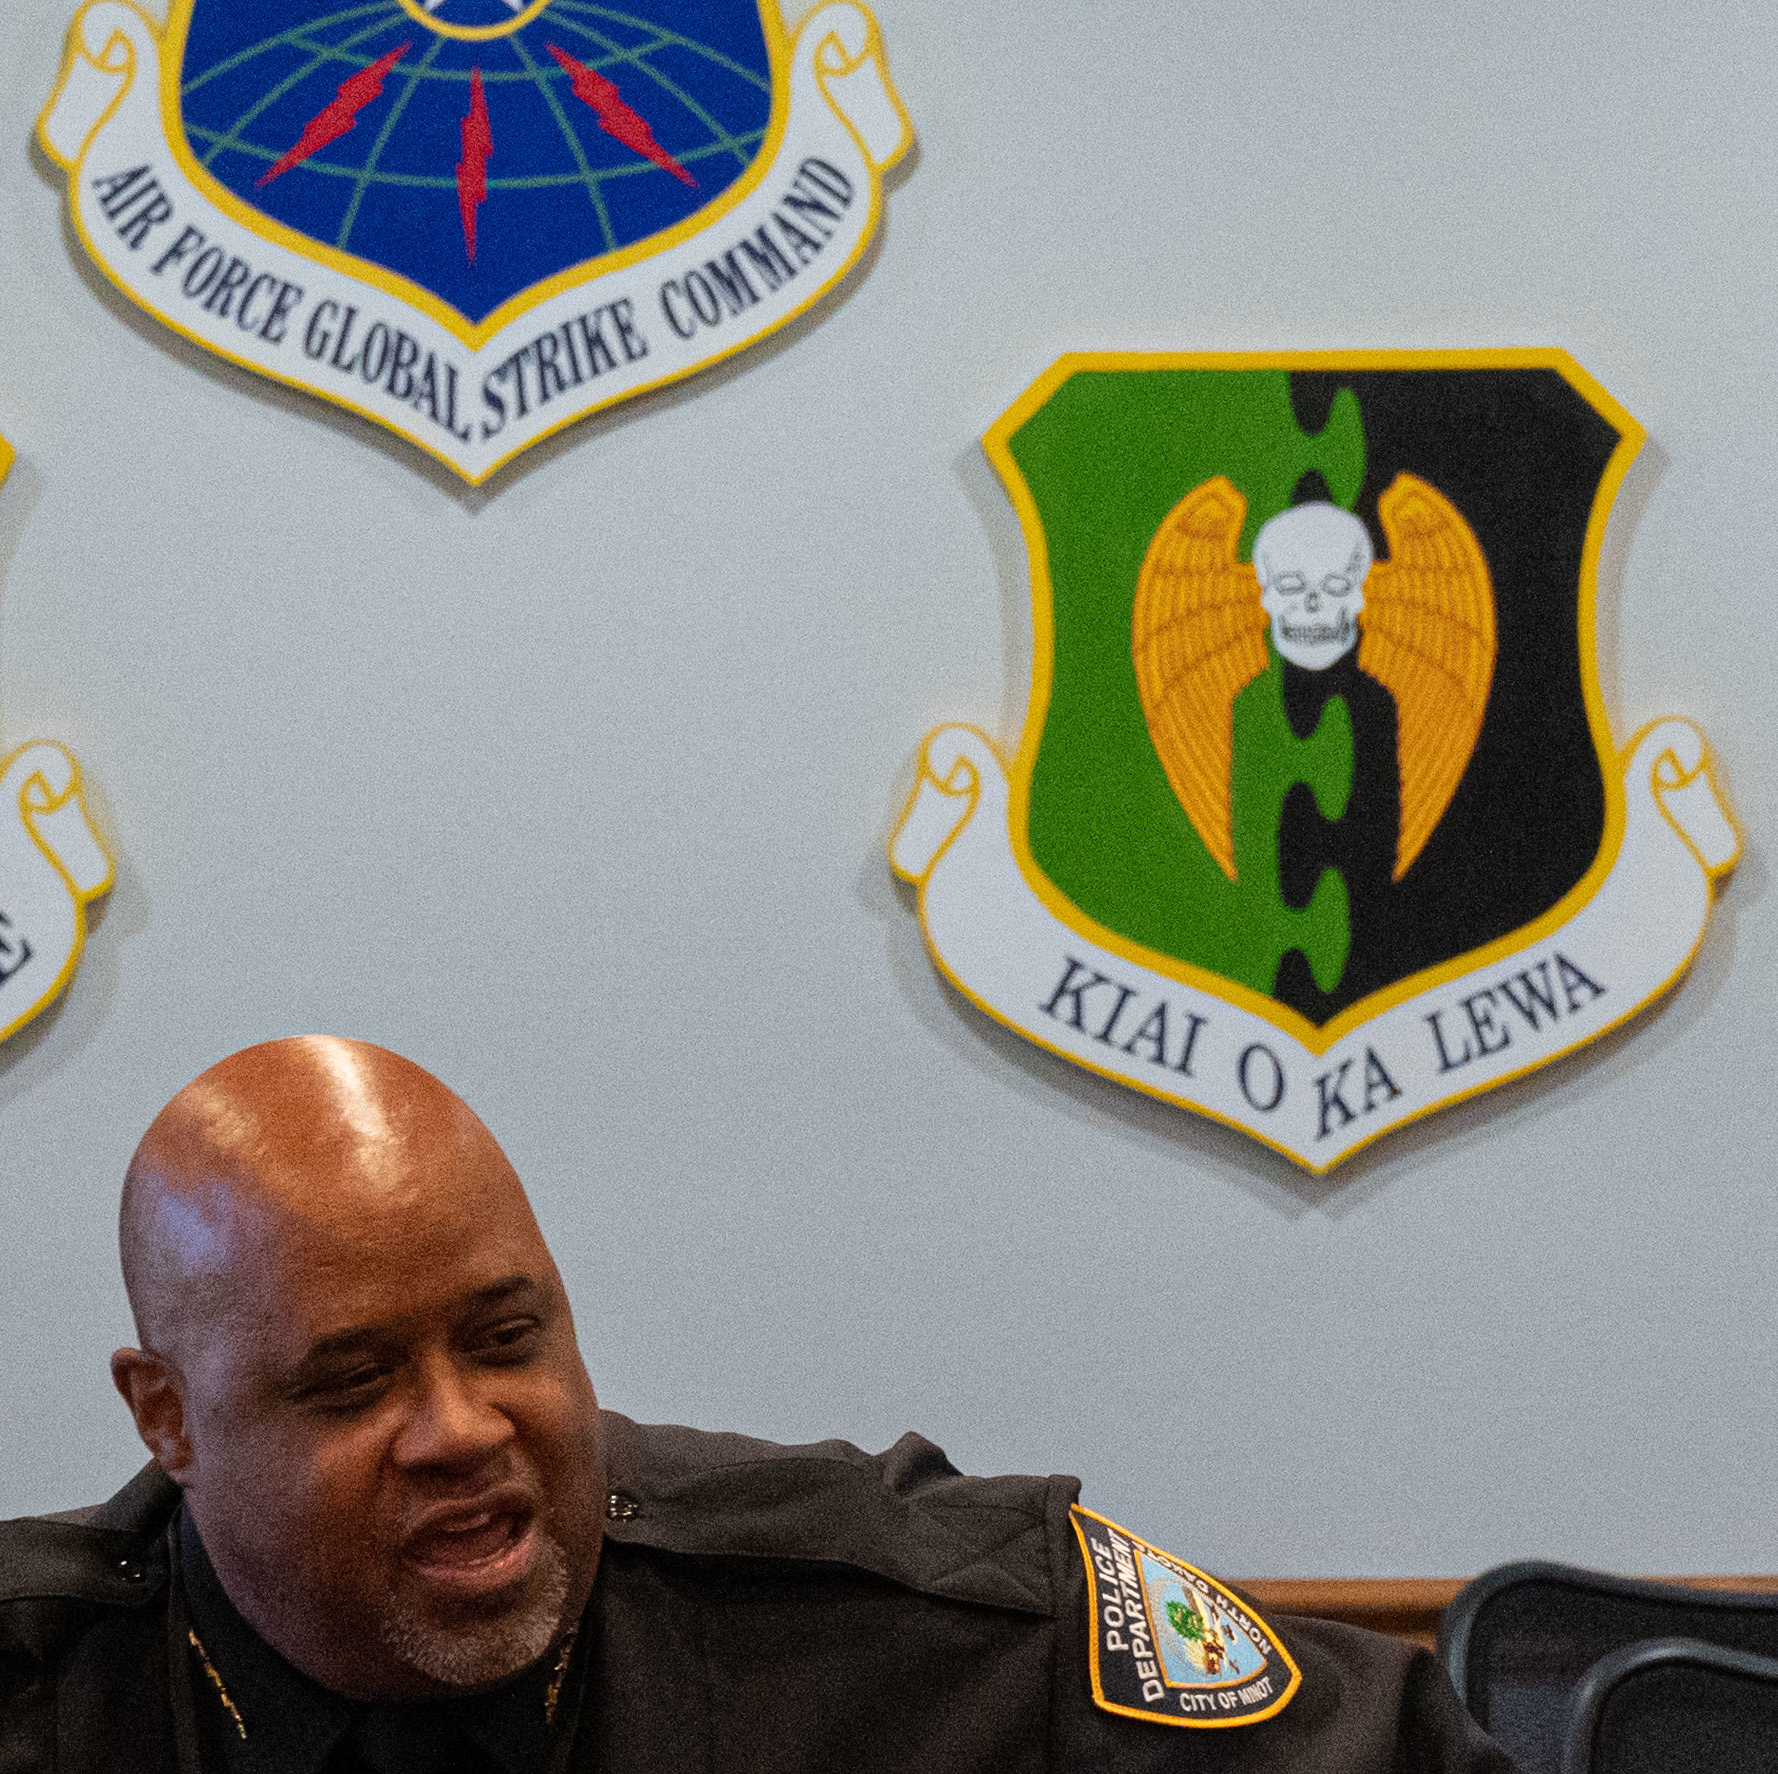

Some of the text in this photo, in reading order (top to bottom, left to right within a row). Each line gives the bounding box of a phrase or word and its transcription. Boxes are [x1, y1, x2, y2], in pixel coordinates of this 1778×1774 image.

[92, 156, 857, 444] AIR FORCE GLOBAL STRIKE COMMAND
[1037, 951, 1607, 1141] KIAI O KA LEWA
[1090, 1537, 1129, 1652] POLICE
[1107, 1527, 1165, 1702] DEPARTMENT
[1216, 1593, 1272, 1655] NORTH
[1179, 1676, 1274, 1712] CITY OF MINOT
